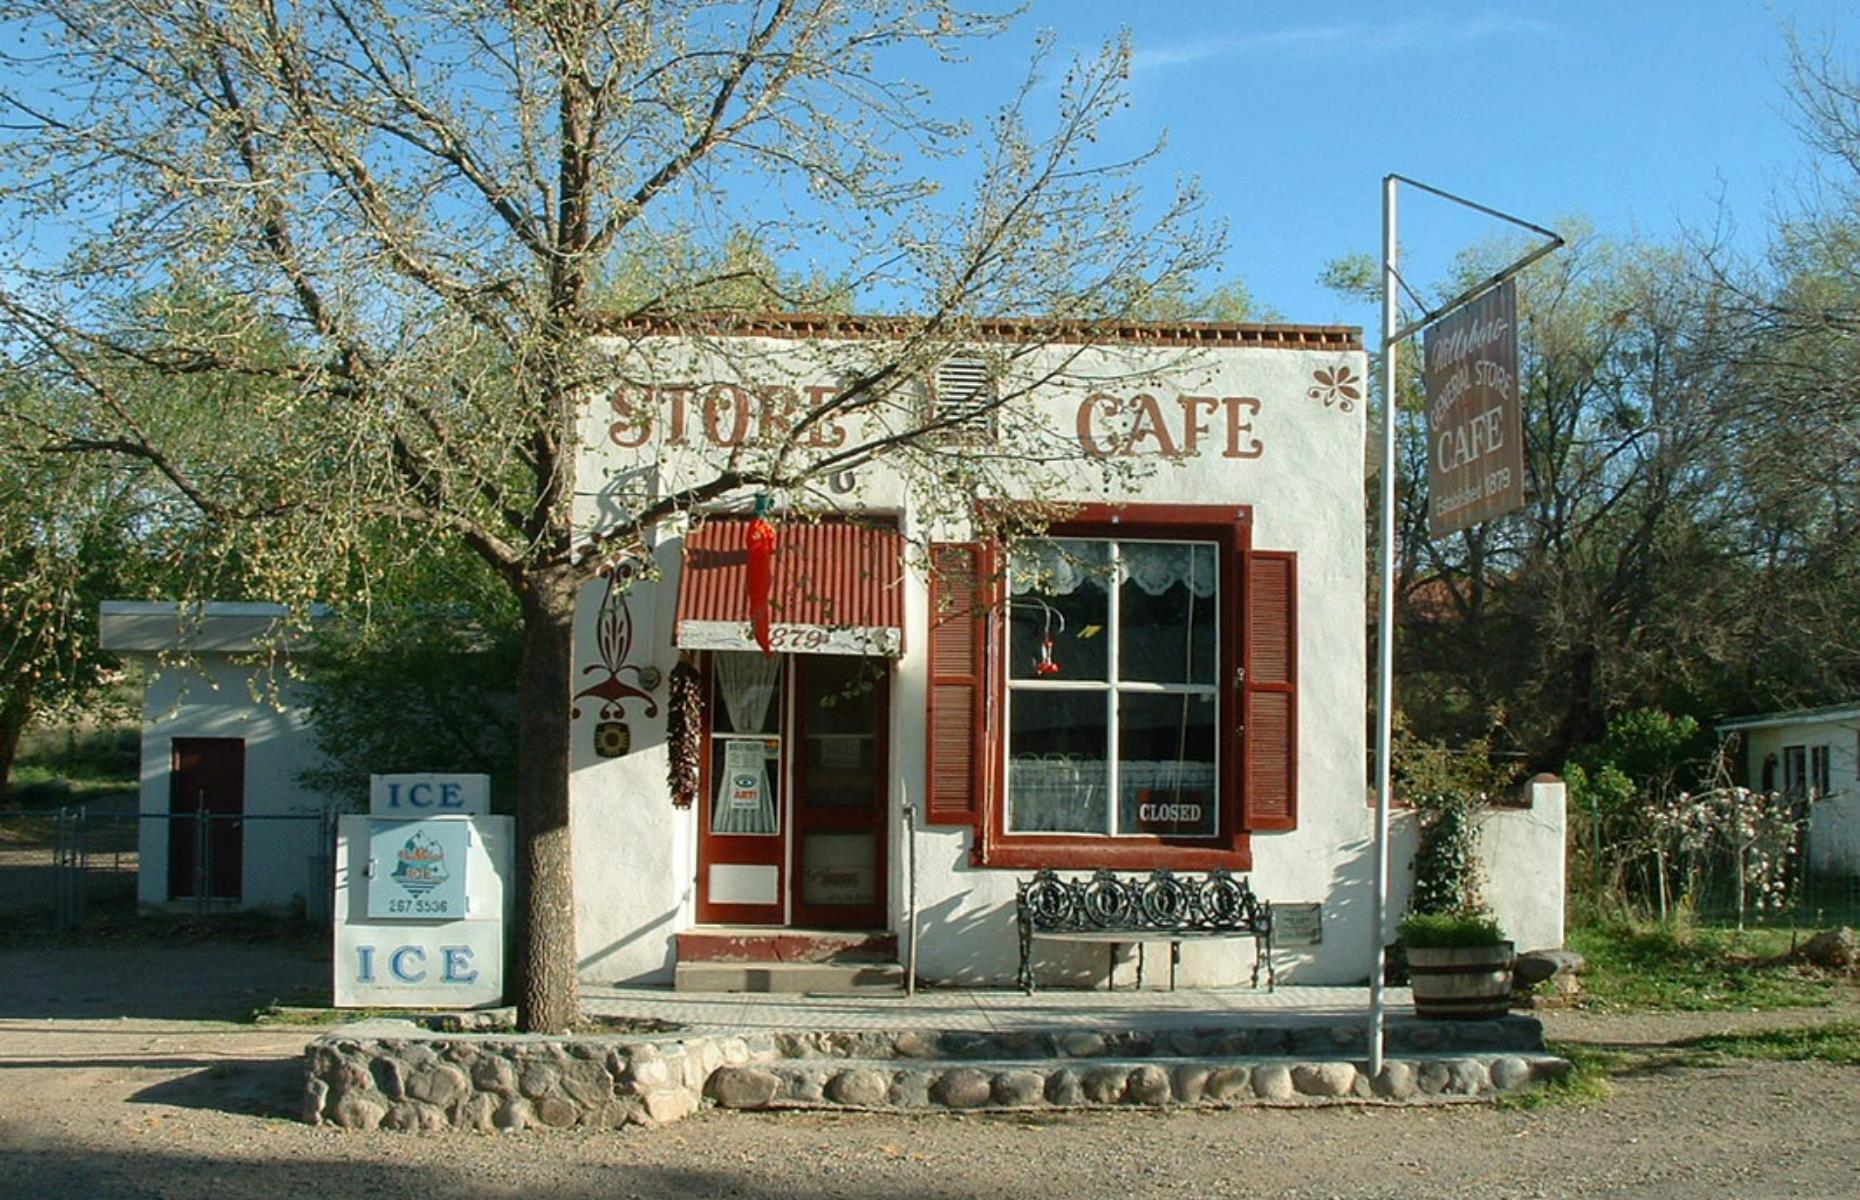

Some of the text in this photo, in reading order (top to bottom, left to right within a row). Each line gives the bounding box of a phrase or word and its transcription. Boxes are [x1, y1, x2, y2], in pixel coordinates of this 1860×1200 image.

[609, 383, 847, 449] STORE
[1430, 360, 1513, 432] GENERAL STORE
[1076, 393, 1264, 460] CAFE
[1437, 405, 1504, 474] CAFE
[1485, 467, 1511, 496] 1879
[768, 627, 823, 650] 879
[387, 783, 465, 809] ICE
[1139, 803, 1201, 822] CLOSED
[355, 945, 479, 985] ICE
